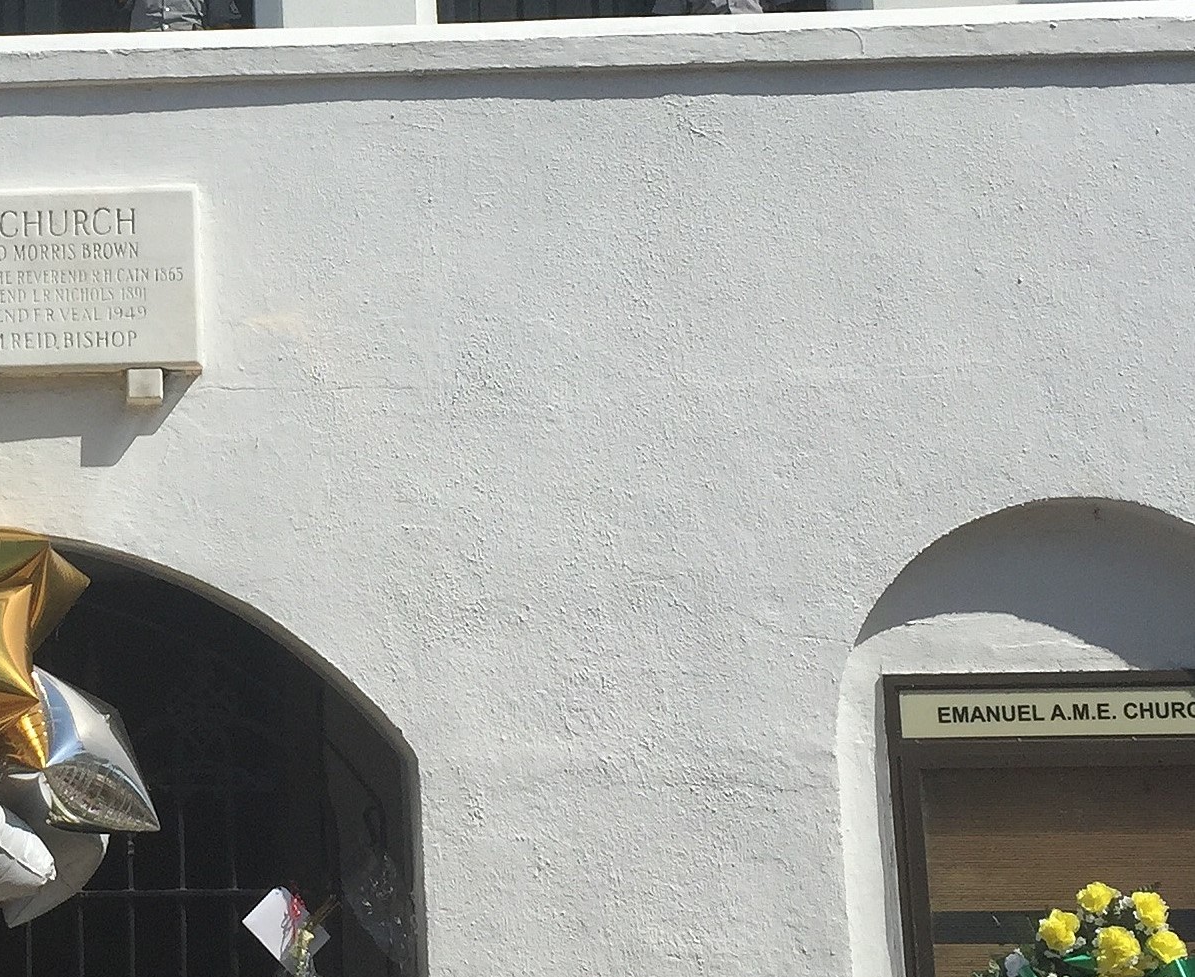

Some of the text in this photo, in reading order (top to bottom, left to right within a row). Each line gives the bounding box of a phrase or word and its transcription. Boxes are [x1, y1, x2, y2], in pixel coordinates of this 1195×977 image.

[13, 242, 76, 262] MORRIS
[82, 241, 139, 260] BROWN
[17, 269, 87, 285] REVEREND
[116, 267, 149, 282] CAIN
[155, 267, 183, 282] 1865
[55, 286, 115, 302] NICHOLS
[59, 306, 103, 321] VEAL
[108, 305, 148, 320] 1949
[64, 330, 137, 349] BISHOP
[937, 704, 1045, 723] EMANUEL
[1051, 703, 1116, 721] A.M.E.
